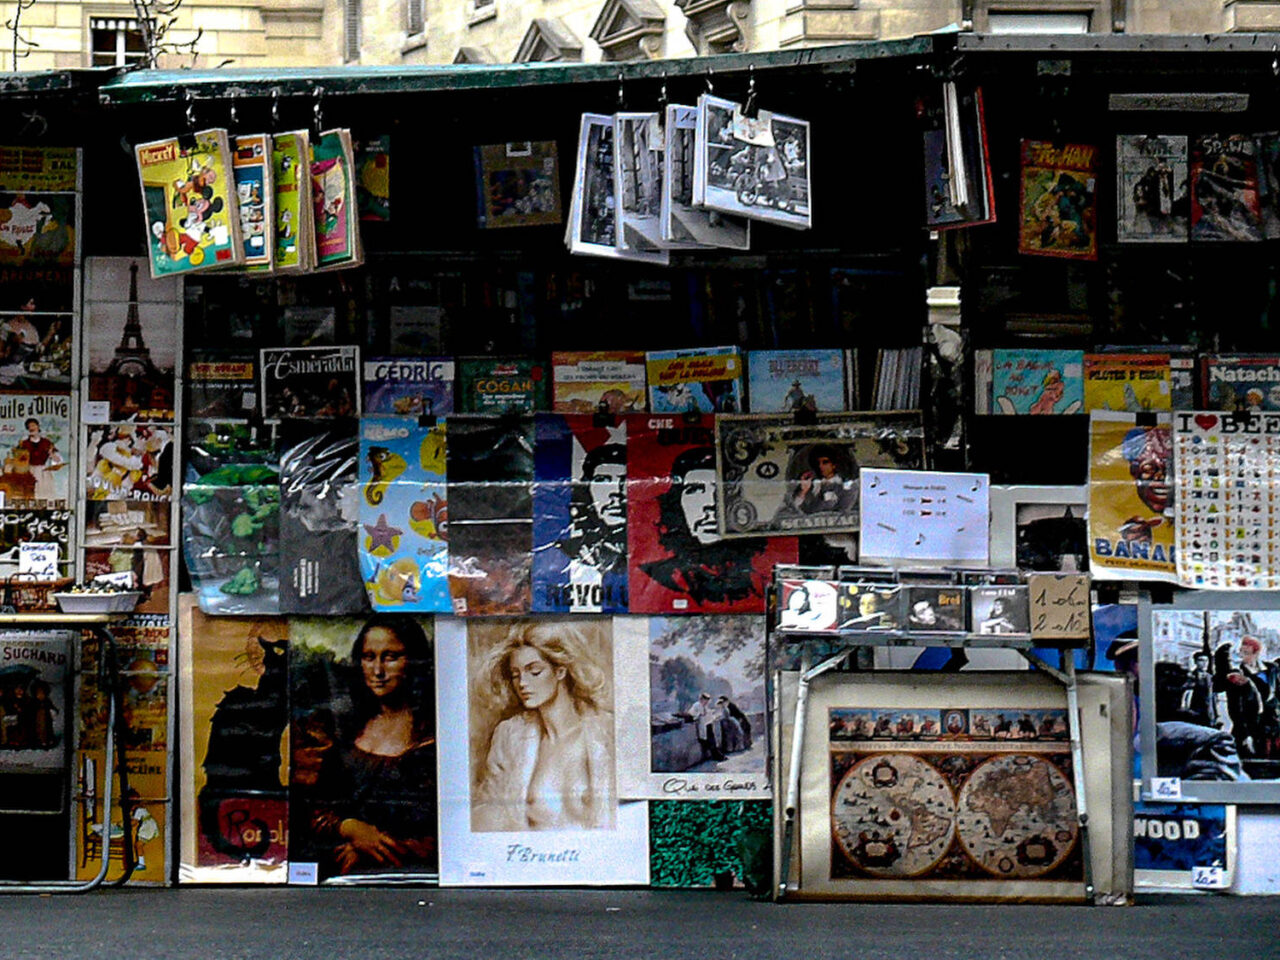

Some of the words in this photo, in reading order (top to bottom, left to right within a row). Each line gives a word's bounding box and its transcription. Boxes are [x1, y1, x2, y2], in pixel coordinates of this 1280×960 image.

[274, 351, 356, 379] Esmeralda
[1209, 366, 1280, 383] Natach
[647, 418, 674, 430] CHE
[1177, 414, 1193, 433] I
[1219, 414, 1280, 434] BEE
[781, 516, 858, 529] SCARFAC
[938, 594, 962, 606] Brel
[3, 647, 67, 665] SUCHARD
